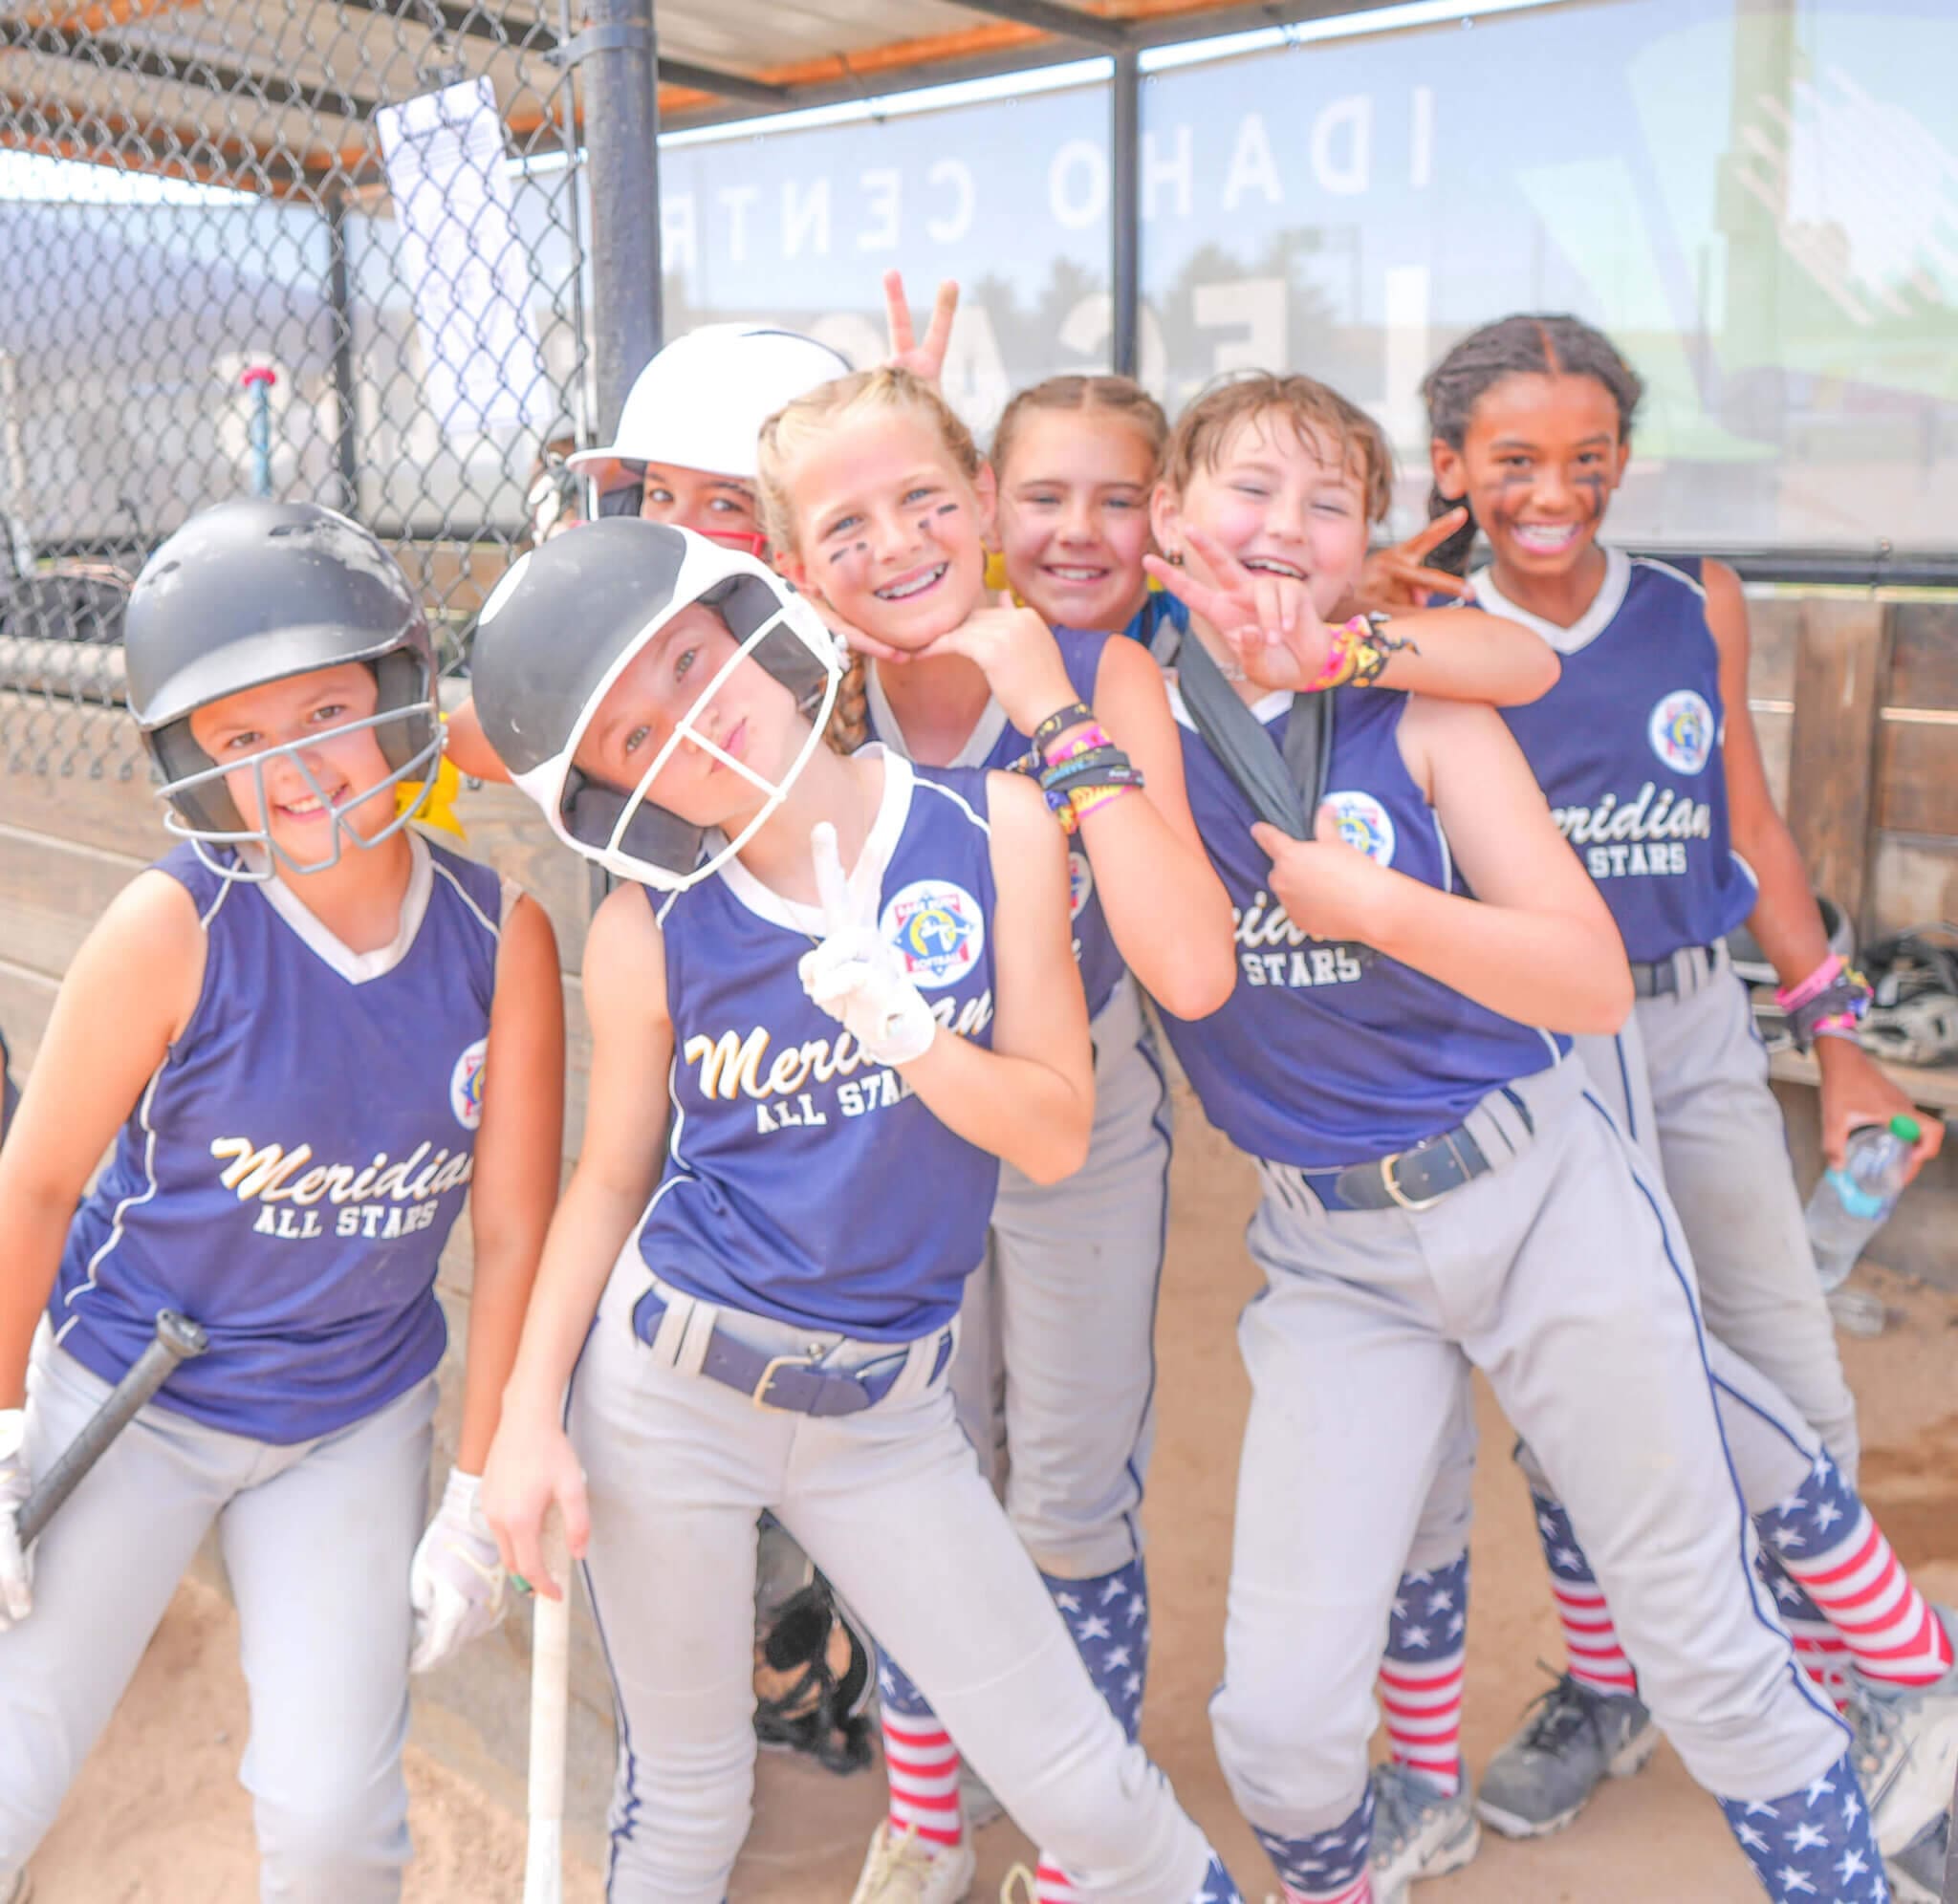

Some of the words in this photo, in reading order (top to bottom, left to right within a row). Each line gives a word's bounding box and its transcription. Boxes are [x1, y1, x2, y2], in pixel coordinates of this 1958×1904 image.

[1587, 841, 1688, 879] STARS
[1240, 946, 1362, 988] STARS
[756, 1093, 827, 1134] ALL
[836, 1068, 915, 1117] STA
[252, 1204, 323, 1239] ALL
[335, 1200, 439, 1240] STARS
